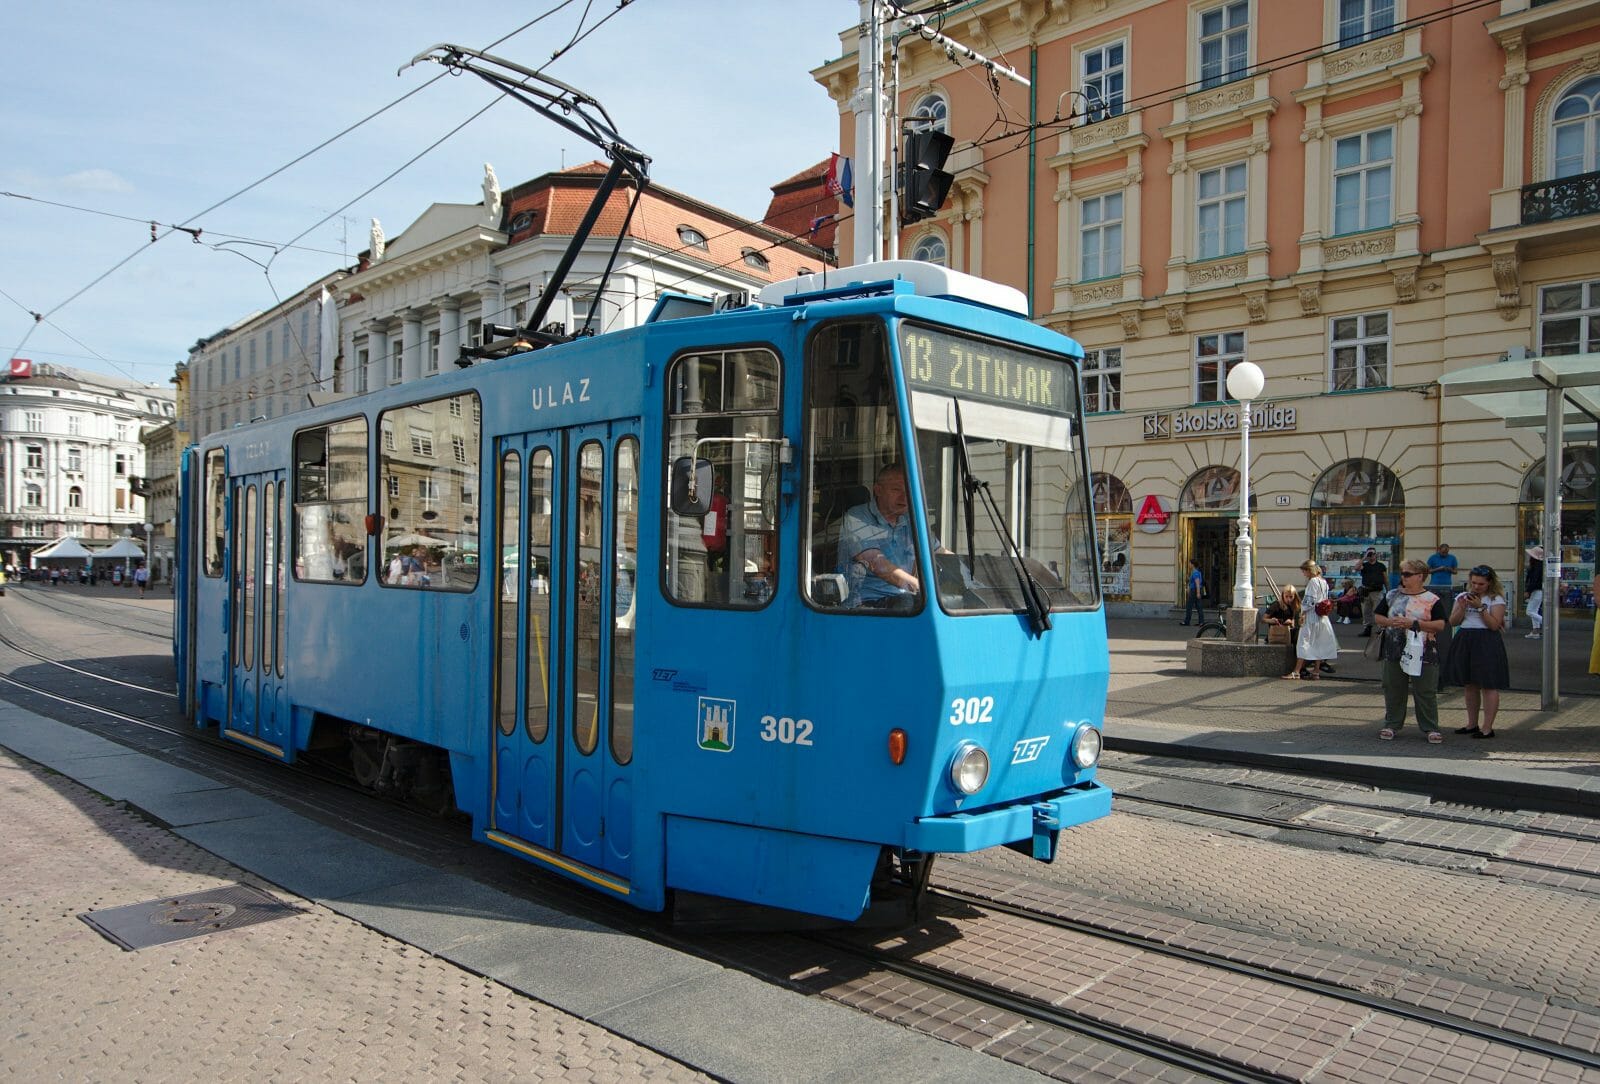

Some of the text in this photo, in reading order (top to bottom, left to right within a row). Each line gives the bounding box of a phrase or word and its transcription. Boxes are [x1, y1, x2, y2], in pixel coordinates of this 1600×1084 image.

[906, 333, 932, 382] 13
[532, 378, 591, 410] ULAZ
[950, 696, 994, 726] 302
[760, 715, 814, 746] 302
[1011, 736, 1050, 765] ZET
